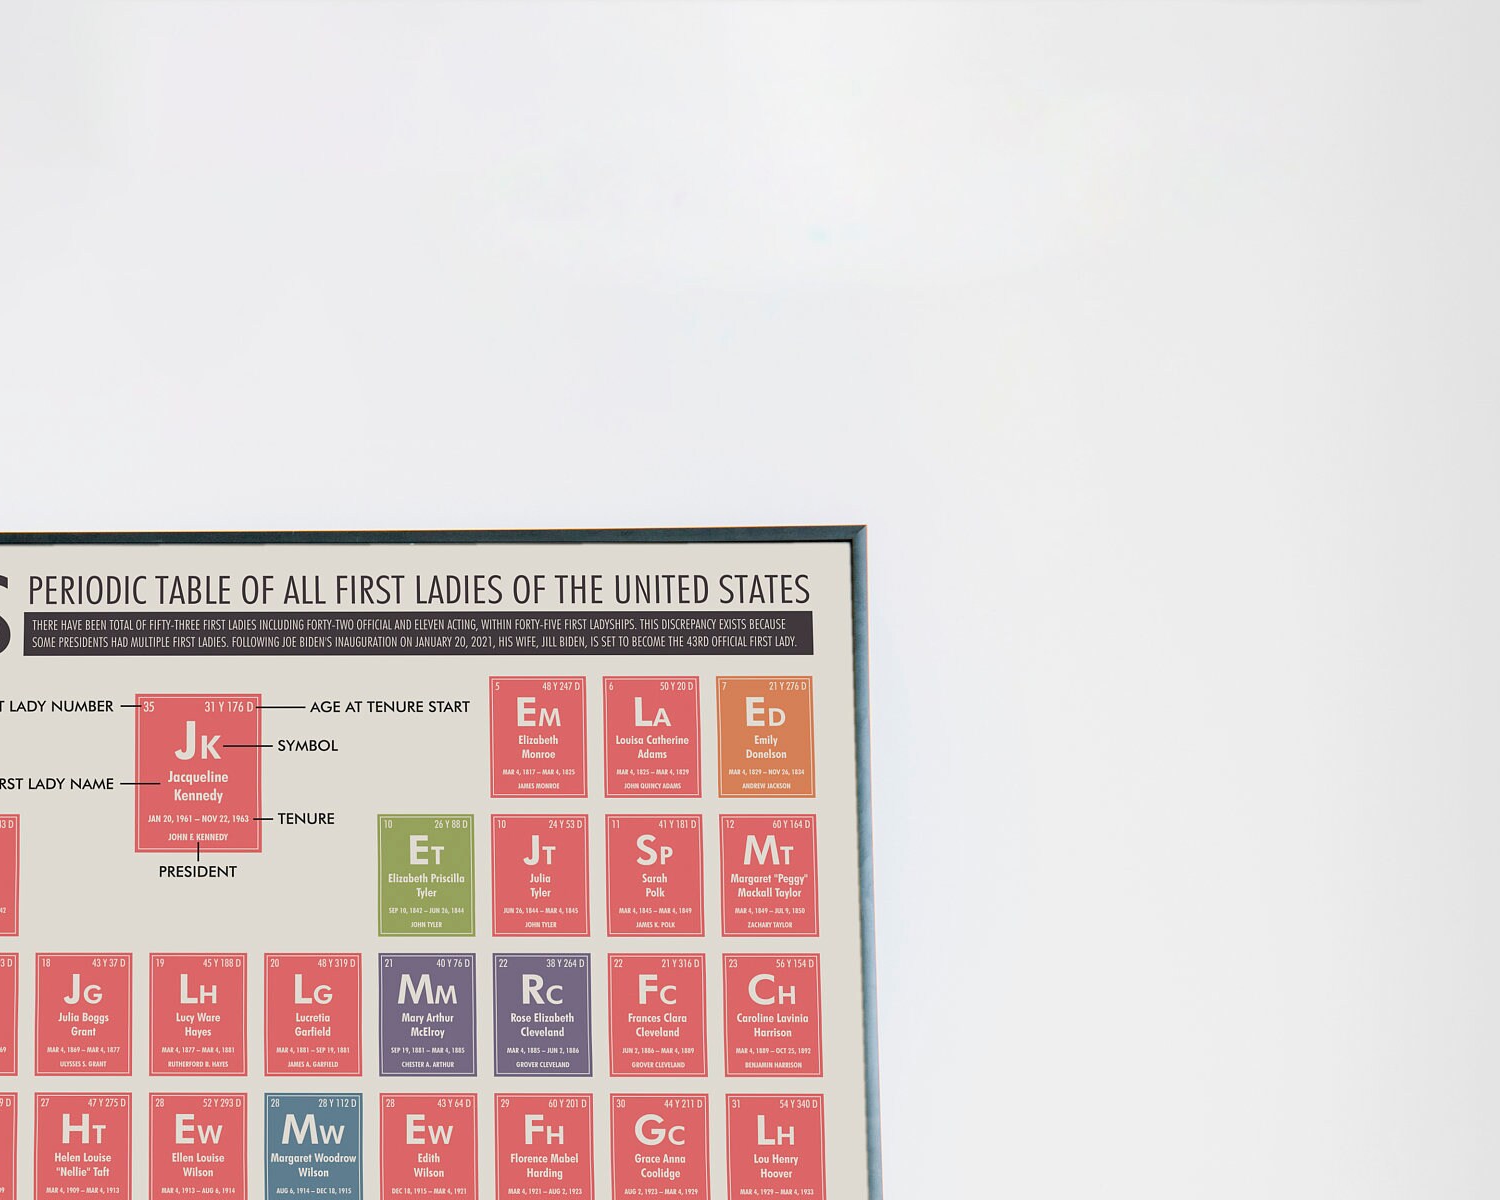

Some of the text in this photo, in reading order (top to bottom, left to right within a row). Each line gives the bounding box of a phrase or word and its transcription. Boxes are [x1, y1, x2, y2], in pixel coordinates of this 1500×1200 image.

[30, 574, 809, 605] PERIODIC TABLE OF ALL FIRST LADIES OF THE UNITED STATES
[32, 618, 786, 631] THERE HAVE BEEN TOTAL OF FIFTY-THREE FIRST LADIES INCLUDING FORTY-TWO OFFICIAL AND ELEVEN ACTING, WITHIN FORTY-FIVE FIRST LADYSHIPS. THIS DISCREPANCY EXISTS BECAUSE
[10, 700, 46, 712] LADY
[52, 700, 113, 712] NUMBER
[143, 701, 155, 712] 35
[205, 701, 253, 712] 31 Y 176 D
[310, 701, 470, 713] AGE AT TENURE START
[519, 735, 558, 744] Elizabeth
[754, 734, 778, 747] Emily
[278, 740, 338, 751] SYMBOL
[522, 749, 555, 759] Monroe
[746, 749, 787, 759] Donelson
[168, 770, 228, 785] Jacqueline
[29, 778, 65, 790] LADY
[71, 778, 114, 790] NAME
[174, 788, 223, 804] Kennedy
[278, 813, 334, 824] TENURE
[159, 866, 237, 878] PRESIDENT
[530, 873, 551, 883] Julia
[642, 873, 667, 883] Sarah
[530, 887, 551, 899] Tyler
[646, 887, 665, 897] Polk
[296, 1012, 330, 1022] Lucretia
[511, 1012, 574, 1022] Rose Elizabeth
[295, 1026, 331, 1036] Garfield
[521, 1027, 564, 1037] Cleveland
[172, 1152, 225, 1162] Ellen Louise
[418, 1153, 440, 1163] Edith
[754, 1154, 798, 1166] Lou Henry
[183, 1167, 213, 1177] Wilson
[414, 1167, 444, 1177] Wilson
[761, 1168, 792, 1178] Hoover
